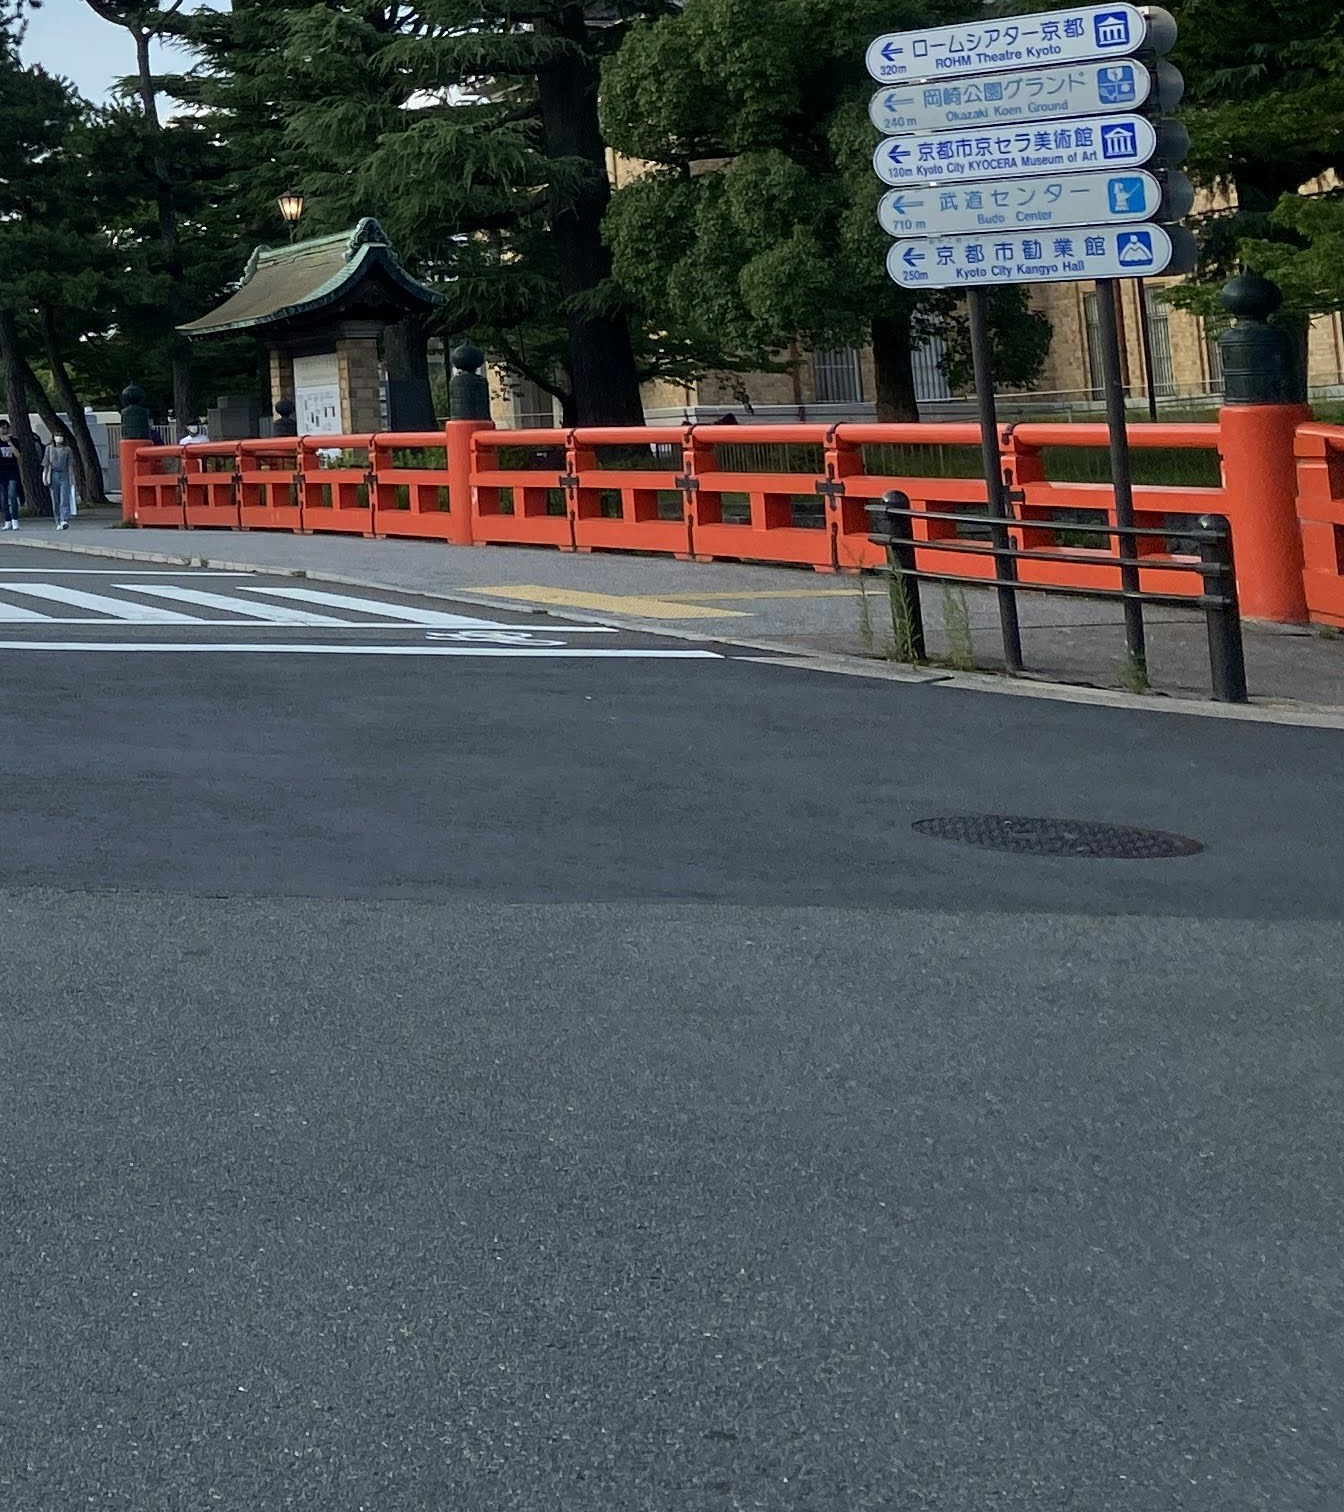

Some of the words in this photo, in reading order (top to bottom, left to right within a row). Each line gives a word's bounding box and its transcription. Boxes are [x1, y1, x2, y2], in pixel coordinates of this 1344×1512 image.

[913, 17, 1085, 58] ロームシアター京都
[880, 64, 907, 76] 320m
[935, 55, 972, 70] ROHM
[976, 49, 1023, 64] Theatre
[1026, 44, 1062, 59] Kyoto
[923, 71, 1086, 109] 岡崎公園グランド
[945, 108, 989, 122] Okazaki
[994, 105, 1022, 116] Koen
[1027, 100, 1069, 114] Ground
[917, 126, 1094, 162] 京都市京セラ美術館
[888, 167, 913, 178] 130m
[916, 164, 944, 177] Kyoto
[946, 162, 965, 175] City
[968, 157, 1018, 172] KYOCERA
[1021, 154, 1064, 167] Museum
[1067, 152, 1078, 163] of
[1081, 149, 1097, 162] Art
[938, 183, 1091, 212] 武道センター
[977, 213, 1006, 225] Budo
[1015, 211, 1053, 223] Center
[935, 235, 1106, 266] 京都市勧業館
[902, 270, 929, 281] 250m
[955, 267, 987, 280] Kyoto
[991, 265, 1013, 277] City
[1016, 263, 1059, 276] Kangyo
[1062, 260, 1085, 271] Hall
